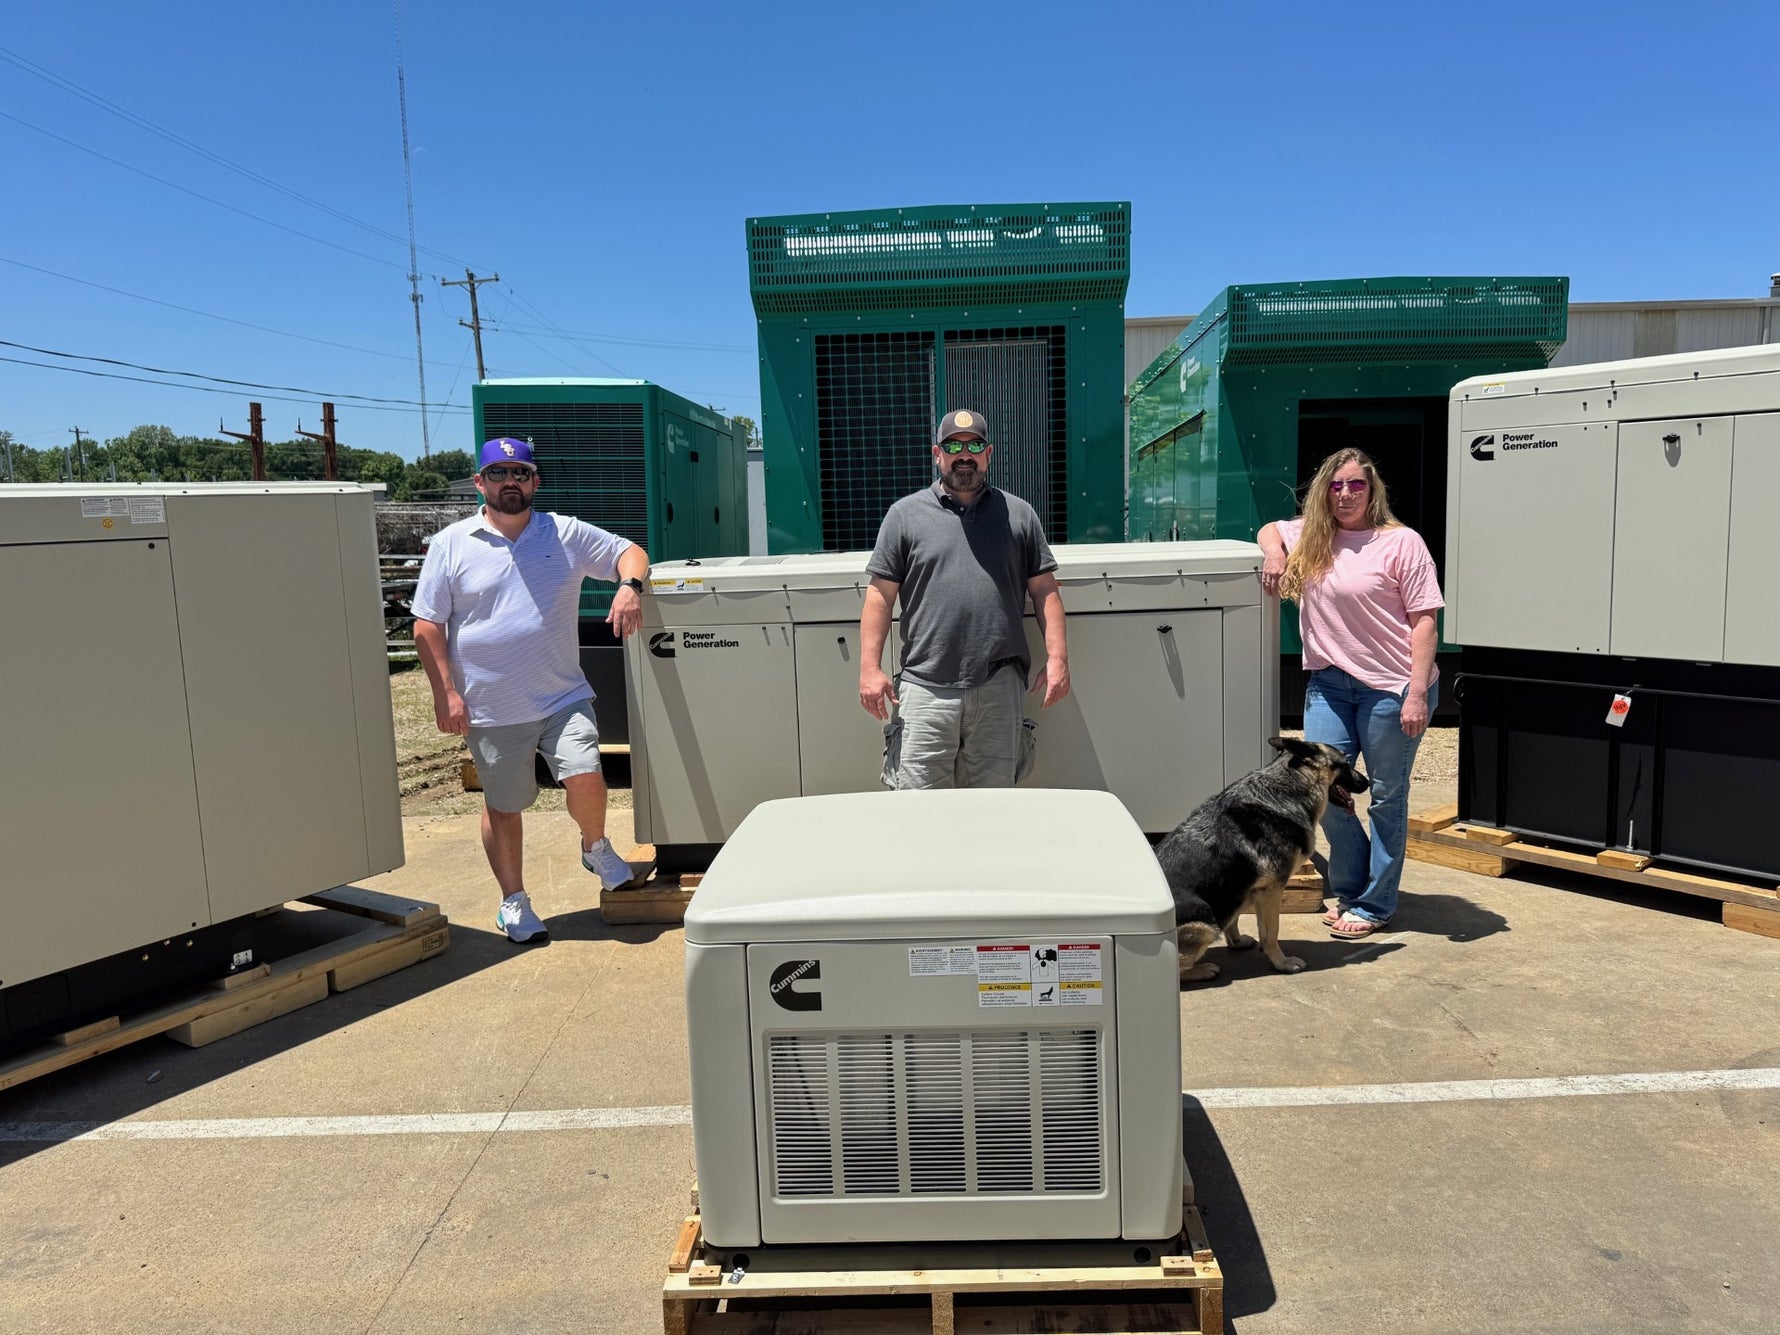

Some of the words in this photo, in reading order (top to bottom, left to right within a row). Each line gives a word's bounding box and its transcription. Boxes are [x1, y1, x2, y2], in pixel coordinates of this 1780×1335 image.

[1502, 433, 1535, 442] Power
[1502, 440, 1558, 451] Generation
[682, 632, 715, 640] Power
[683, 639, 739, 649] Generation
[770, 959, 816, 993] Cummins
